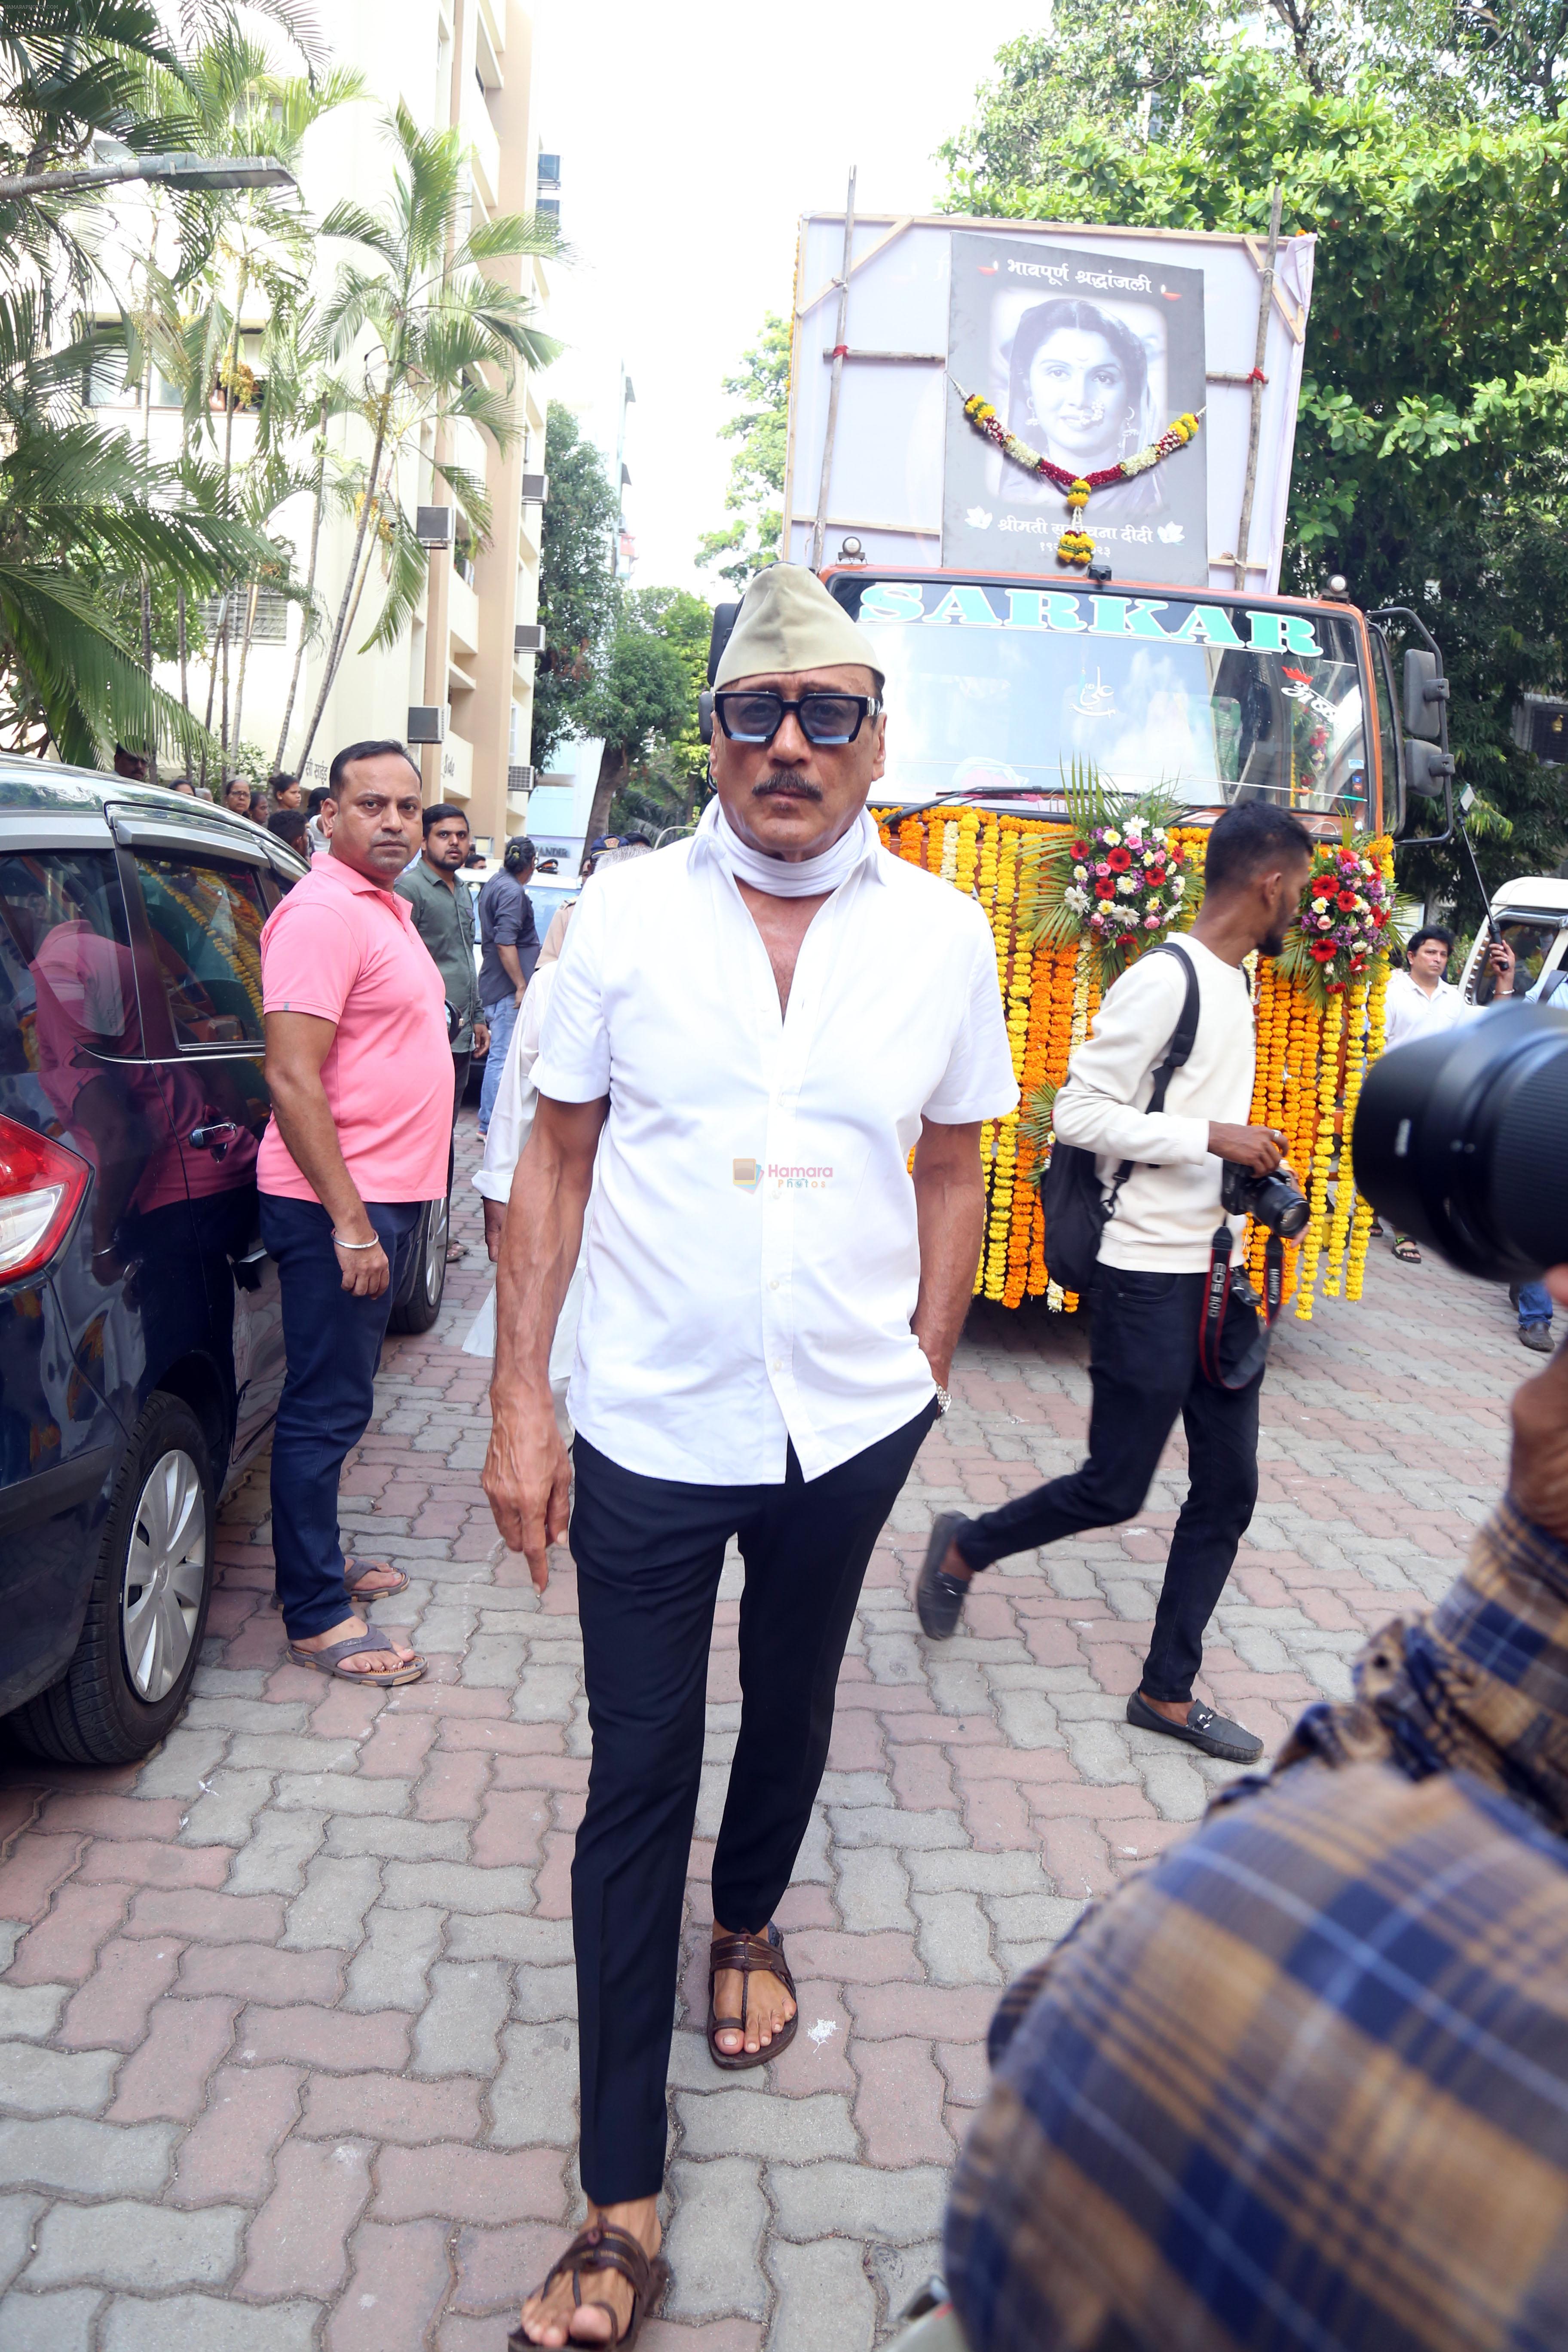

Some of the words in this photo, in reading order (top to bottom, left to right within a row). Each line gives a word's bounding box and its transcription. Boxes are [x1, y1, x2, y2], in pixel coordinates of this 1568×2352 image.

[1007, 259, 1070, 286] भावपूर्ण
[1075, 269, 1152, 293] श्रद्धांजली
[997, 515, 1048, 534] श्रीमती
[1120, 524, 1154, 544] दीदी
[859, 582, 1324, 658] SARKAR
